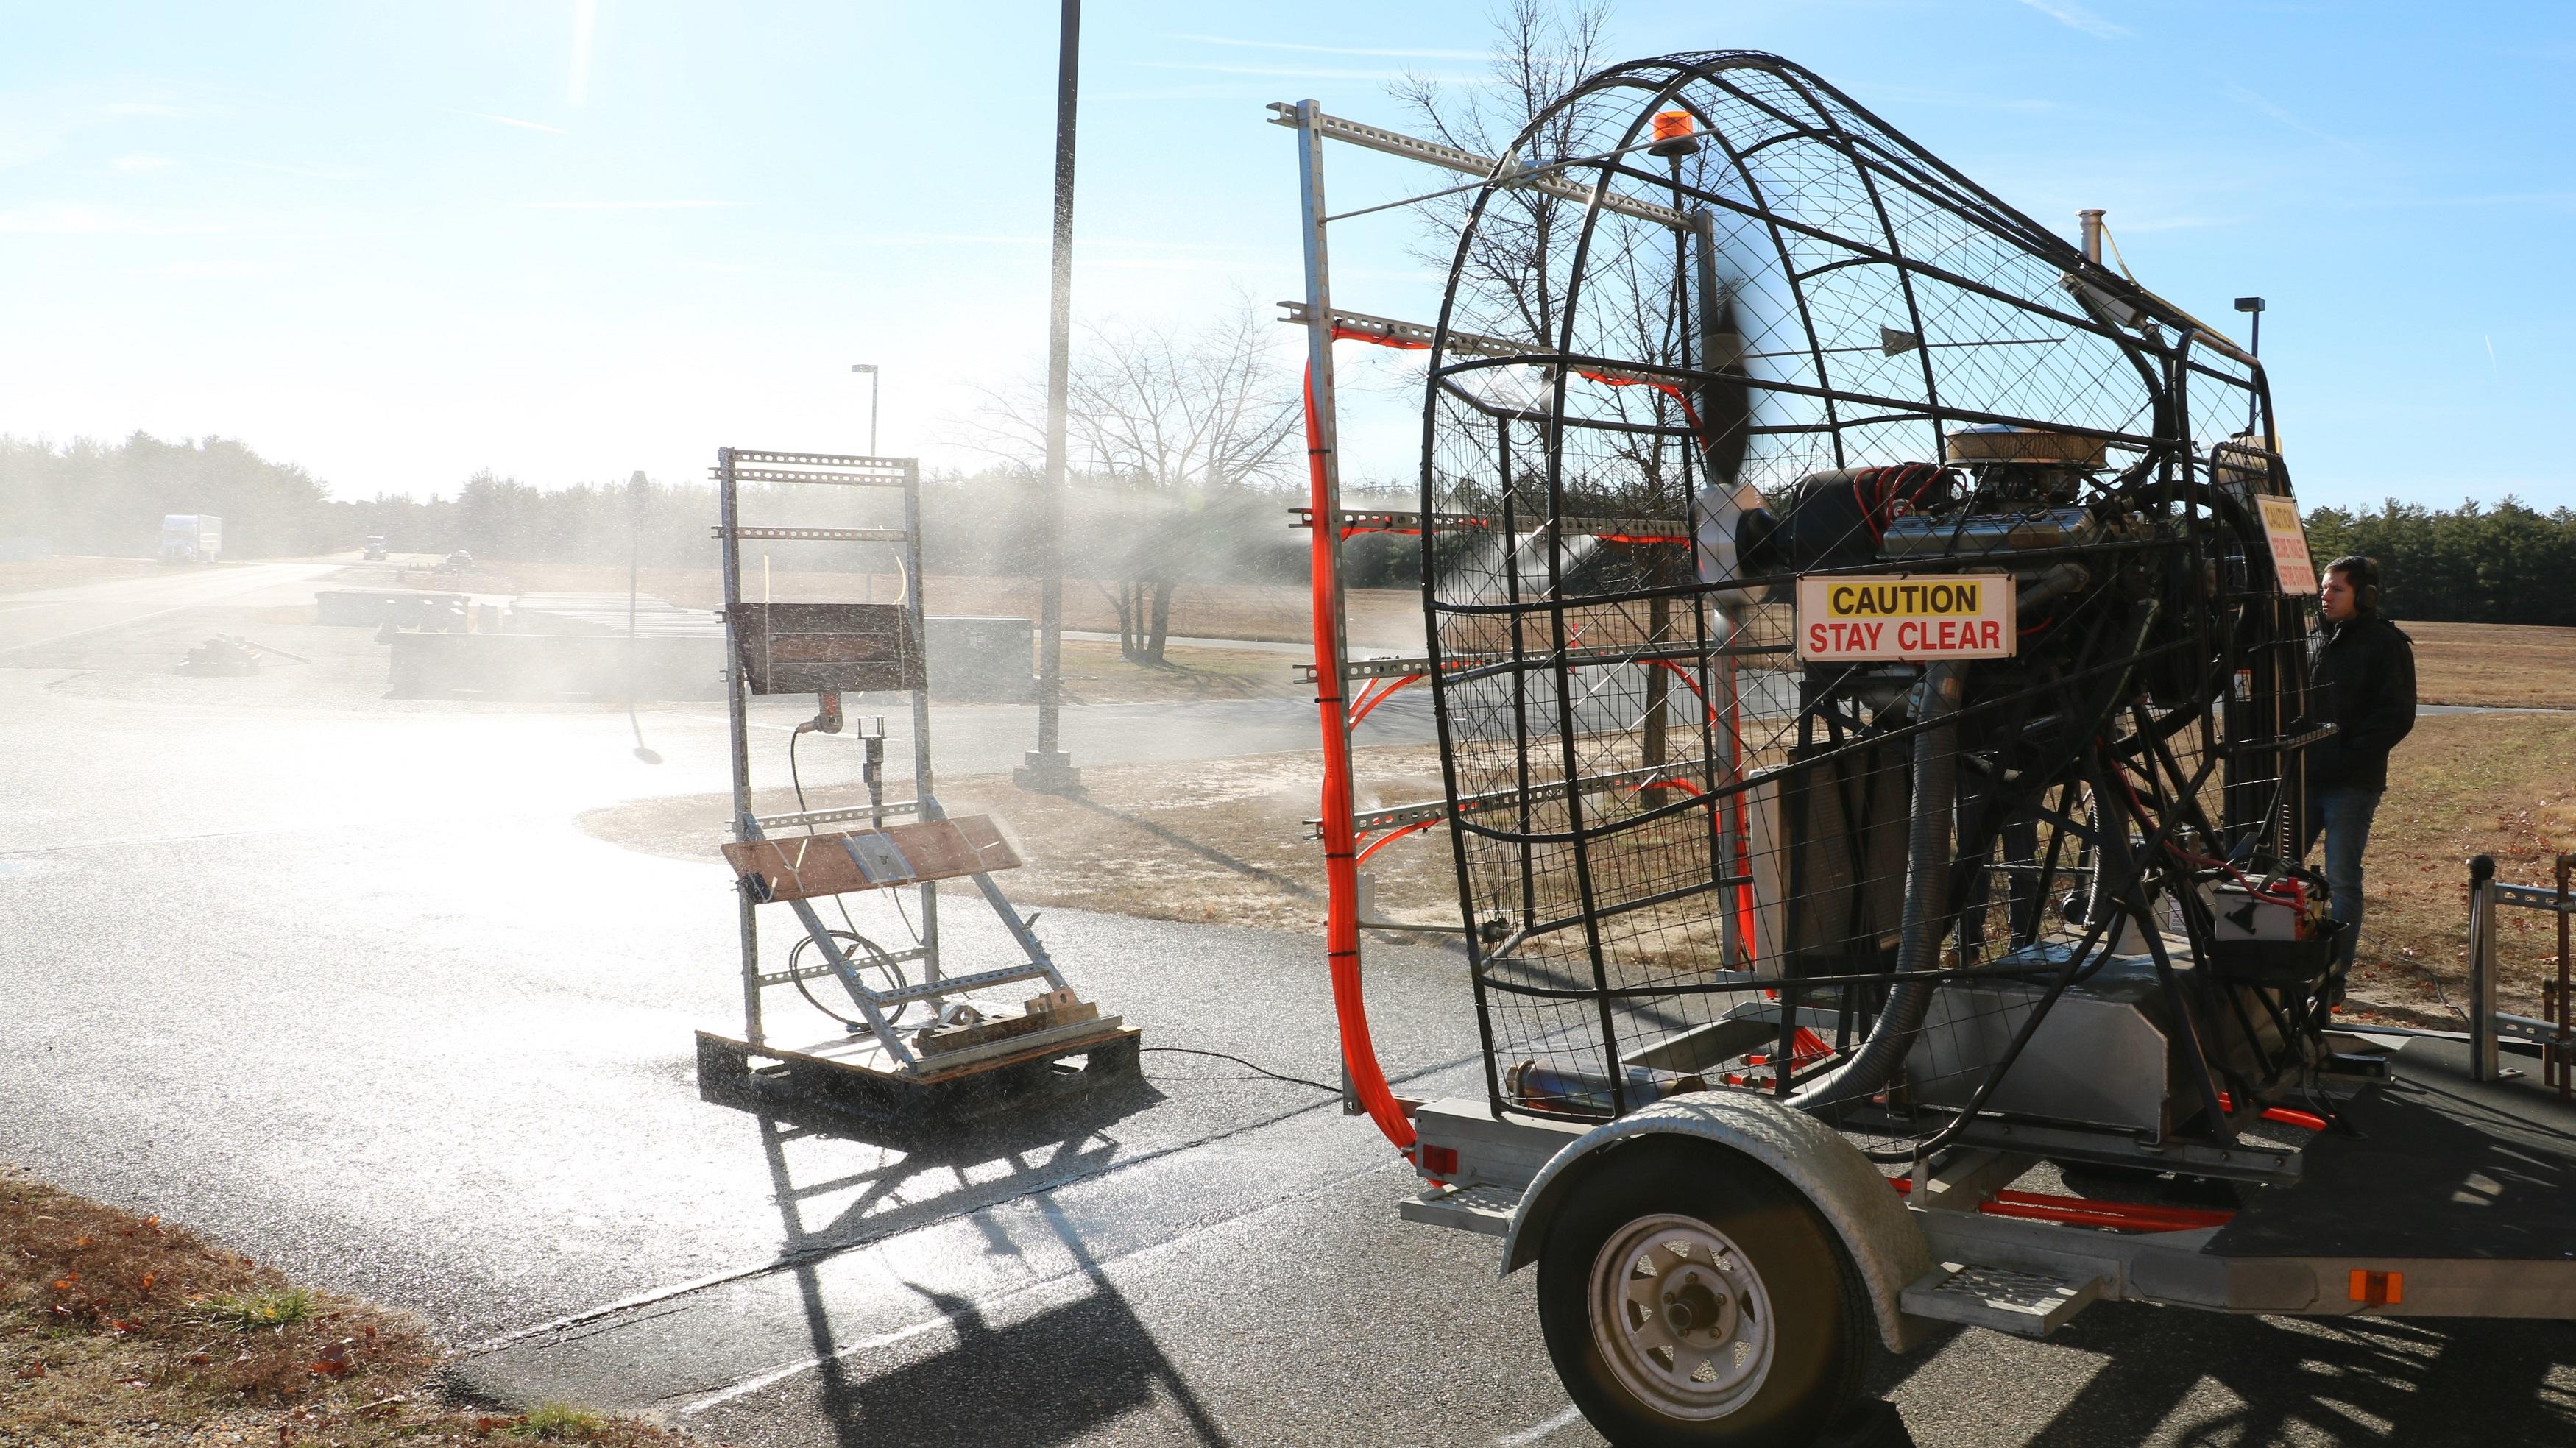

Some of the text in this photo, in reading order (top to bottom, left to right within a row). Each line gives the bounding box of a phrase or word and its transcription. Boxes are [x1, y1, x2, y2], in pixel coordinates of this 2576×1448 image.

[2265, 505, 2296, 530] CAUTION
[1833, 584, 1977, 615] CAUTION
[1809, 620, 2000, 653] STAY CLEAR
